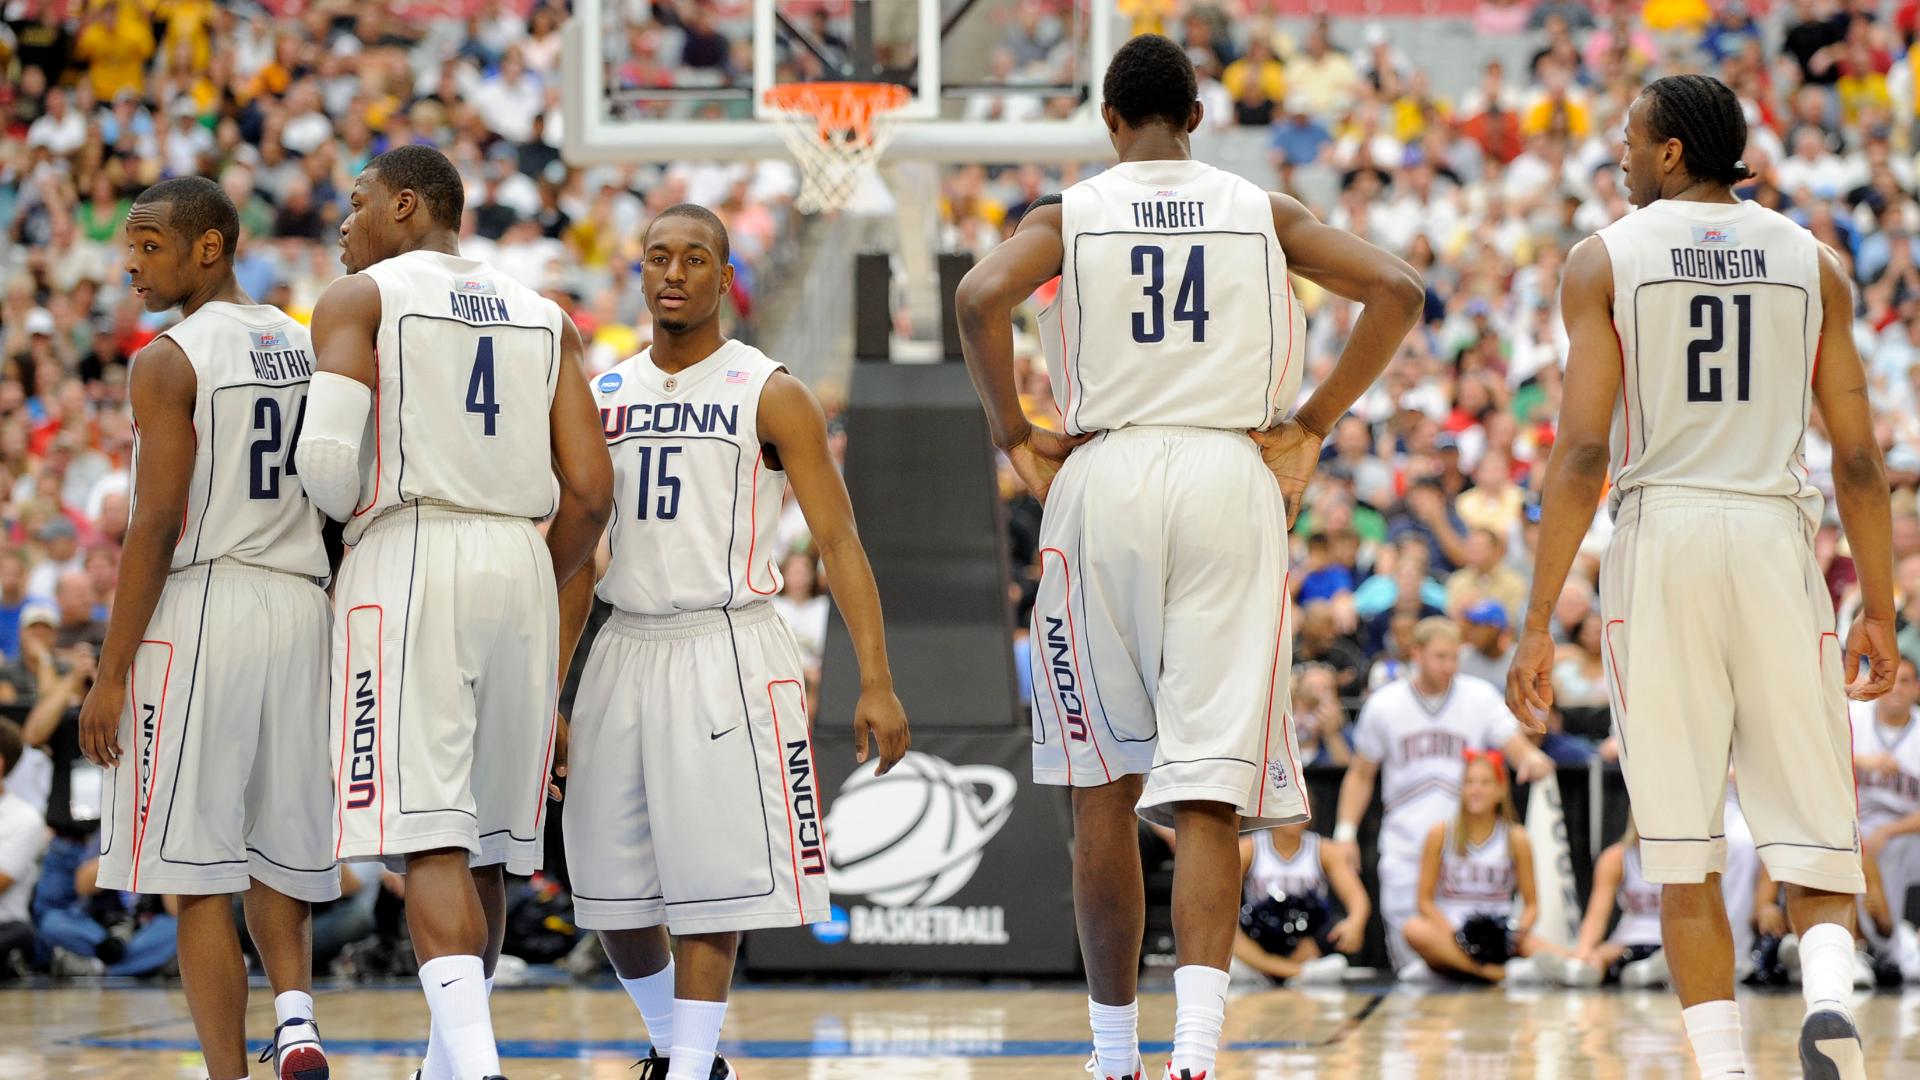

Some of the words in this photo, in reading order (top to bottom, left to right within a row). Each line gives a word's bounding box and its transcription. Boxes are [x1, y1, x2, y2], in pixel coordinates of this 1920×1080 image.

[1131, 201, 1205, 229] THABEET
[1670, 248, 1768, 280] ROBINSON
[449, 291, 511, 322] ADRIEN
[1131, 245, 1210, 343] 34
[465, 336, 500, 437] 4
[1687, 294, 1751, 402] 21
[600, 403, 738, 439] UCONN
[637, 446, 683, 521] 15
[1046, 616, 1088, 743] UCONN
[141, 703, 155, 823] CONN
[346, 669, 376, 810] UCONN
[787, 739, 825, 876] UCONN
[848, 905, 1010, 945] BASKETBALL
